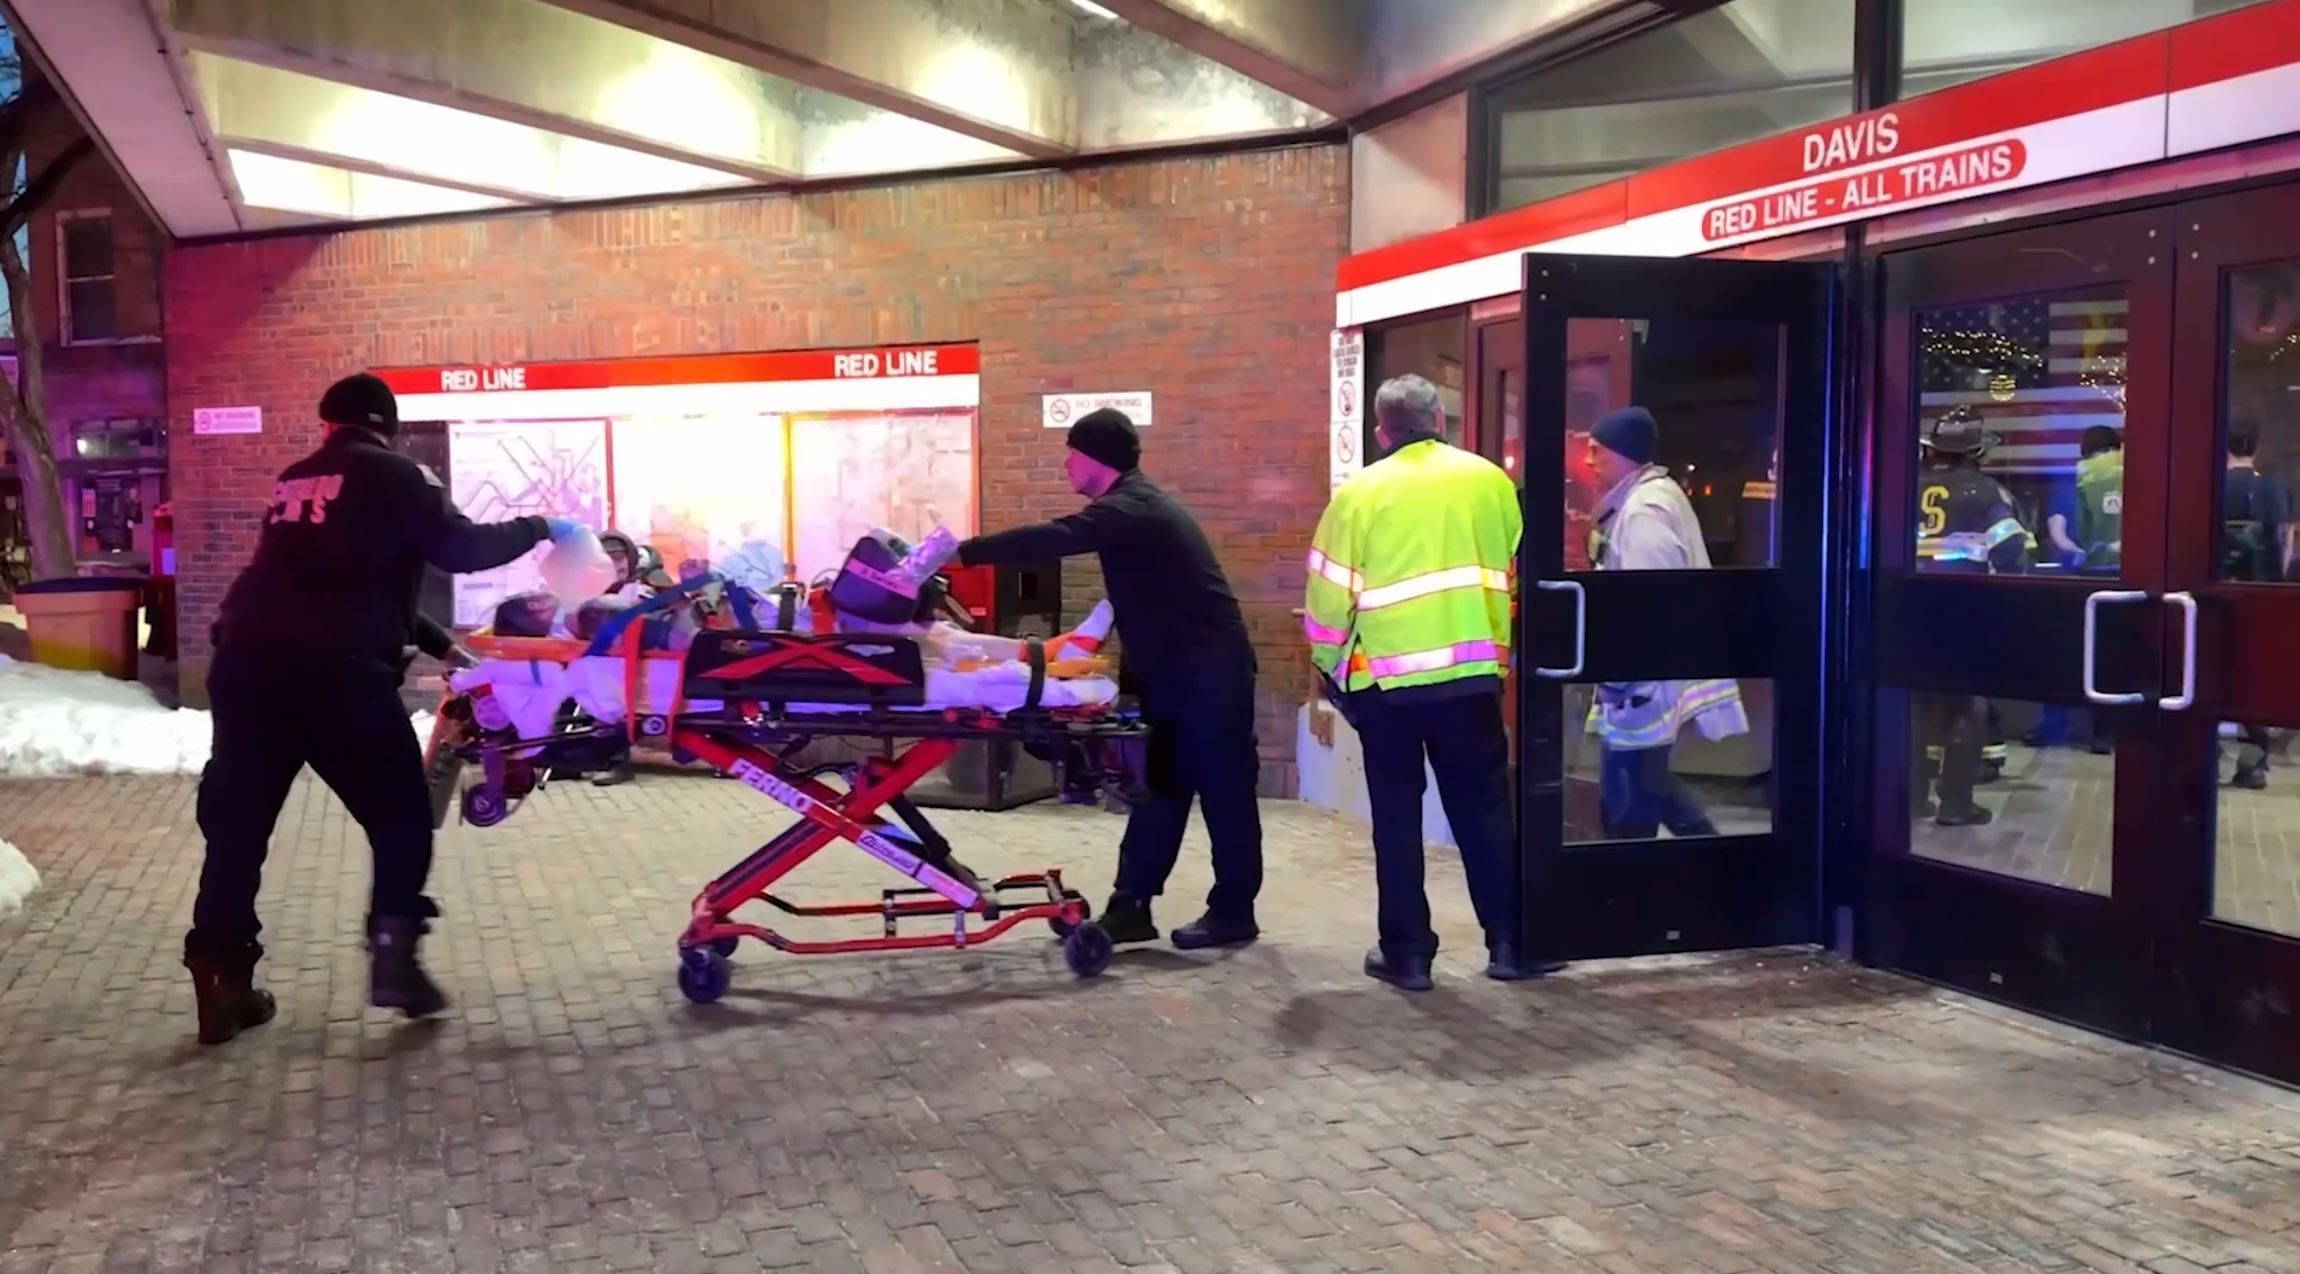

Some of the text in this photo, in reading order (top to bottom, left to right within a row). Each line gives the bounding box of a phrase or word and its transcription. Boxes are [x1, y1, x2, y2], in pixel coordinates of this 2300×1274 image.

[1803, 112, 1899, 172] DAVIS
[1710, 205, 1757, 238] RED
[1764, 187, 1818, 225] LINE
[1842, 173, 1893, 210] ALL
[1900, 145, 2012, 197] TRAINS
[441, 367, 526, 392] RED LINE
[834, 350, 939, 377] RED LINE
[728, 757, 814, 816] FERNO
